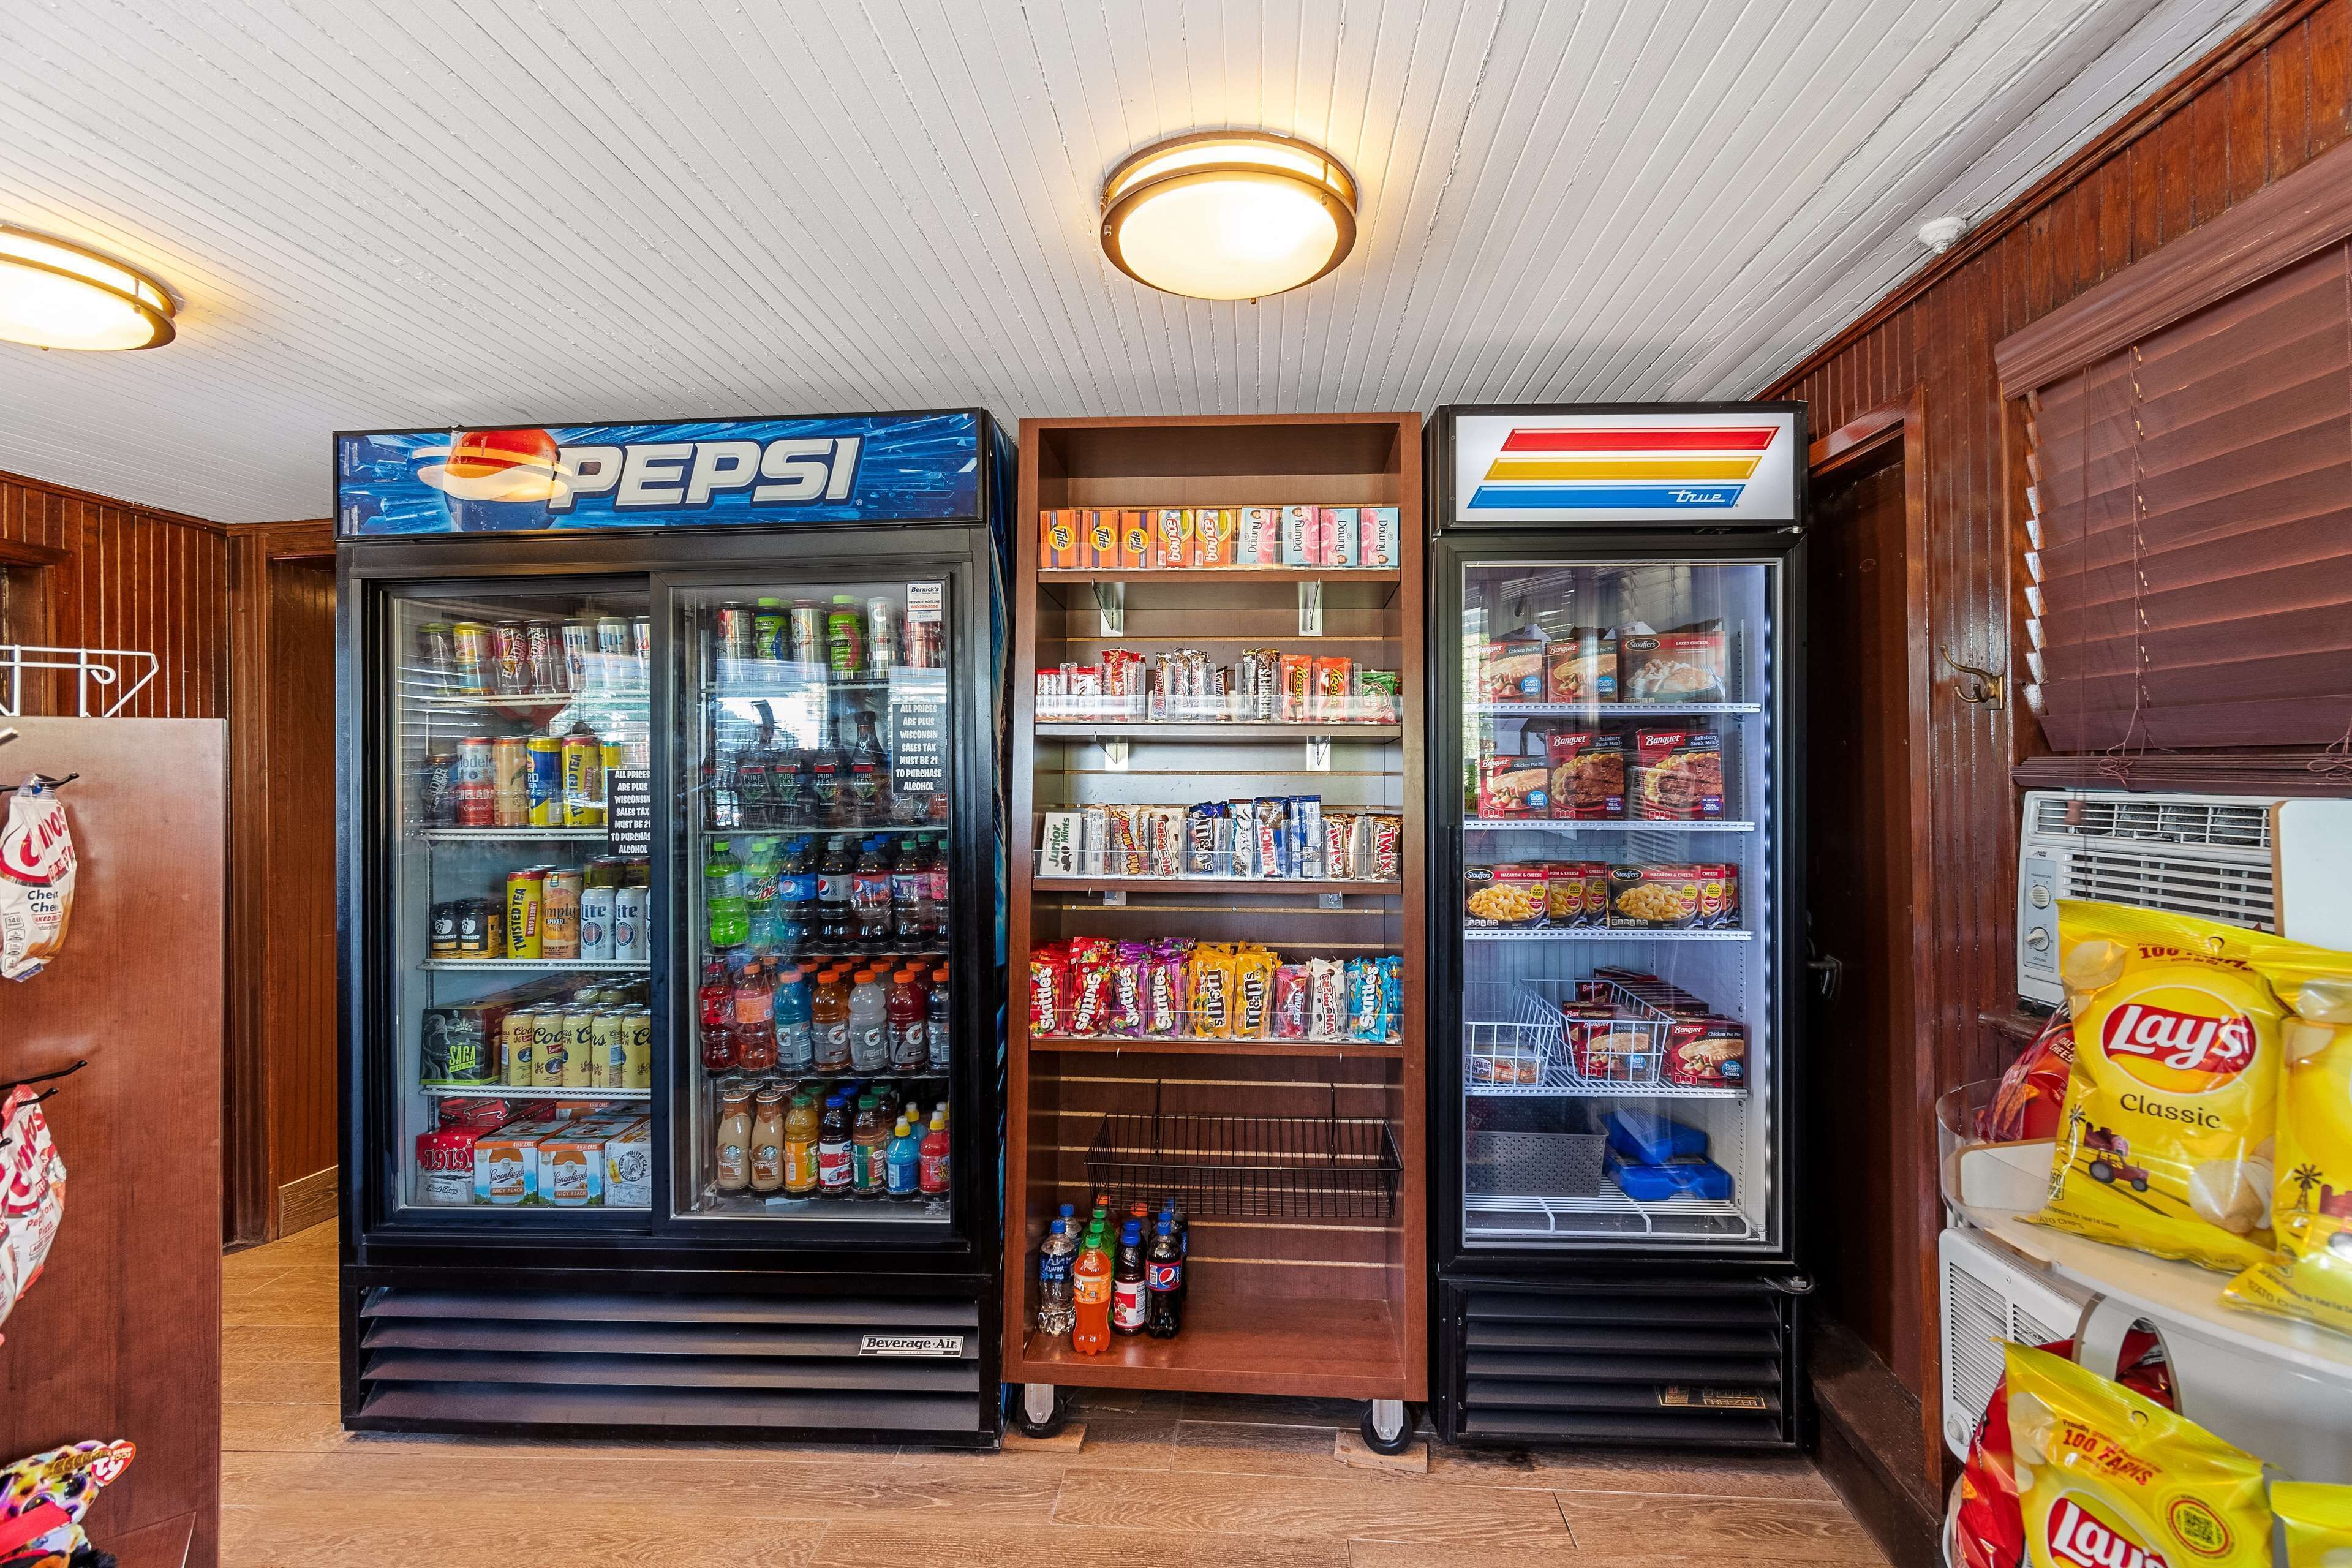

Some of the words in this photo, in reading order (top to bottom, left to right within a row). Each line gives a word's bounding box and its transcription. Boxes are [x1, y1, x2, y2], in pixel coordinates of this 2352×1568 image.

[549, 437, 861, 507] PEPSI
[1668, 491, 1726, 503] true
[1053, 527, 1069, 548] Tide
[1096, 528, 1110, 549] Tide
[1129, 530, 1145, 551] Tide
[1248, 521, 1262, 553] Downy
[1293, 519, 1305, 552] Downy
[1335, 520, 1347, 552] Downy
[1376, 520, 1388, 552] Downy
[1550, 645, 1577, 654] Banquet
[900, 704, 912, 713] ALL
[913, 704, 937, 713] PRICES
[903, 717, 916, 726] ARE
[918, 717, 934, 726] PLUS
[900, 730, 938, 739] WISCONSIN
[1553, 736, 1586, 747] Banquet
[1646, 735, 1681, 746] Banquet
[902, 743, 921, 752] SALES
[923, 743, 936, 752] TAX
[900, 756, 918, 764] MUST
[919, 756, 929, 764] BE
[930, 756, 938, 764] 21
[1482, 759, 1509, 767] Banquet
[895, 769, 905, 777] TO
[906, 769, 942, 777] PURCHASE
[903, 782, 934, 790] ALCOHOL
[614, 795, 650, 804] WISCONSIN
[616, 807, 635, 816] SALES
[636, 807, 649, 816] TAX
[615, 820, 633, 829] MUST
[633, 820, 643, 829] BE
[644, 820, 650, 829] 21
[1061, 818, 1069, 843] Mints
[621, 832, 650, 841] PURCHAS
[1049, 824, 1061, 867] Junior
[619, 845, 648, 854] ALCOHOL
[512, 888, 527, 907] TEA
[527, 902, 537, 935] RASPBERRY
[511, 908, 527, 951] TWISTED
[1038, 968, 1056, 1030] Skittles
[1076, 973, 1101, 1030] Skittles
[1119, 967, 1139, 1026] Skittles
[1154, 967, 1172, 1030] Skittles
[1360, 966, 1379, 1028] Skittles
[1294, 992, 1304, 1025] Twizzlers
[2108, 1004, 2249, 1070] Lay's
[450, 1046, 475, 1065] SAGA
[862, 1049, 883, 1058] FROST
[2120, 1093, 2222, 1128] Classic
[424, 1149, 469, 1171] 1919
[625, 1151, 643, 1161] WHITE
[639, 1158, 647, 1178] CLAW
[2063, 1429, 2098, 1452] 100
